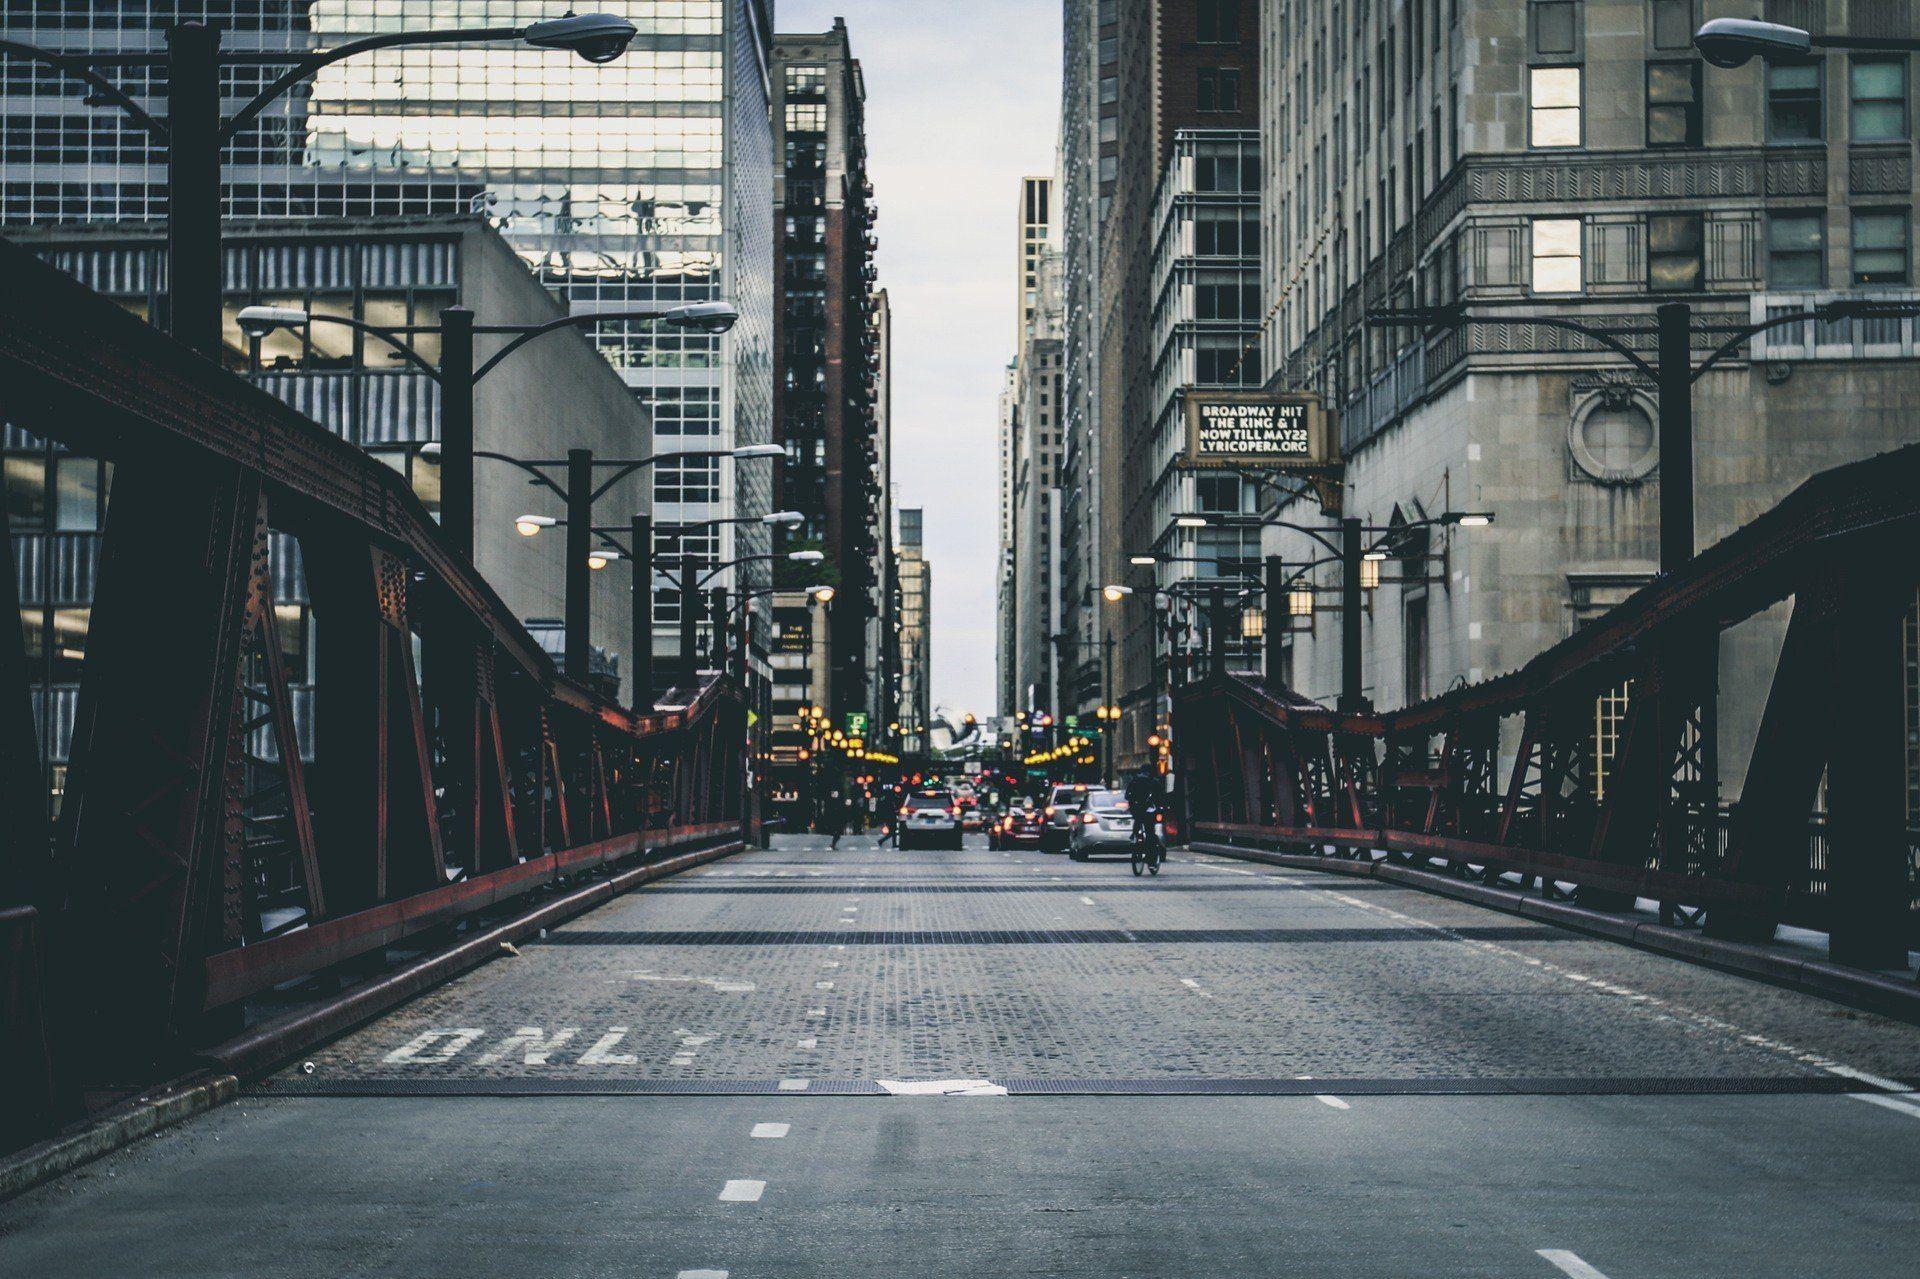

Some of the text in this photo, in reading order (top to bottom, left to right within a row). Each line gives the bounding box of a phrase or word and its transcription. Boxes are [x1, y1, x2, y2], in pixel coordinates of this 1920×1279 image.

[1202, 406, 1303, 417] BROADWAY HIT
[1208, 418, 1235, 428] THE
[1240, 418, 1273, 429] KING
[1277, 418, 1287, 429] &
[1200, 429, 1231, 440] NOW
[1233, 429, 1261, 440] TILL
[1200, 441, 1307, 452] LYRICOPERA.ORG
[382, 1027, 722, 1066] ONLY
